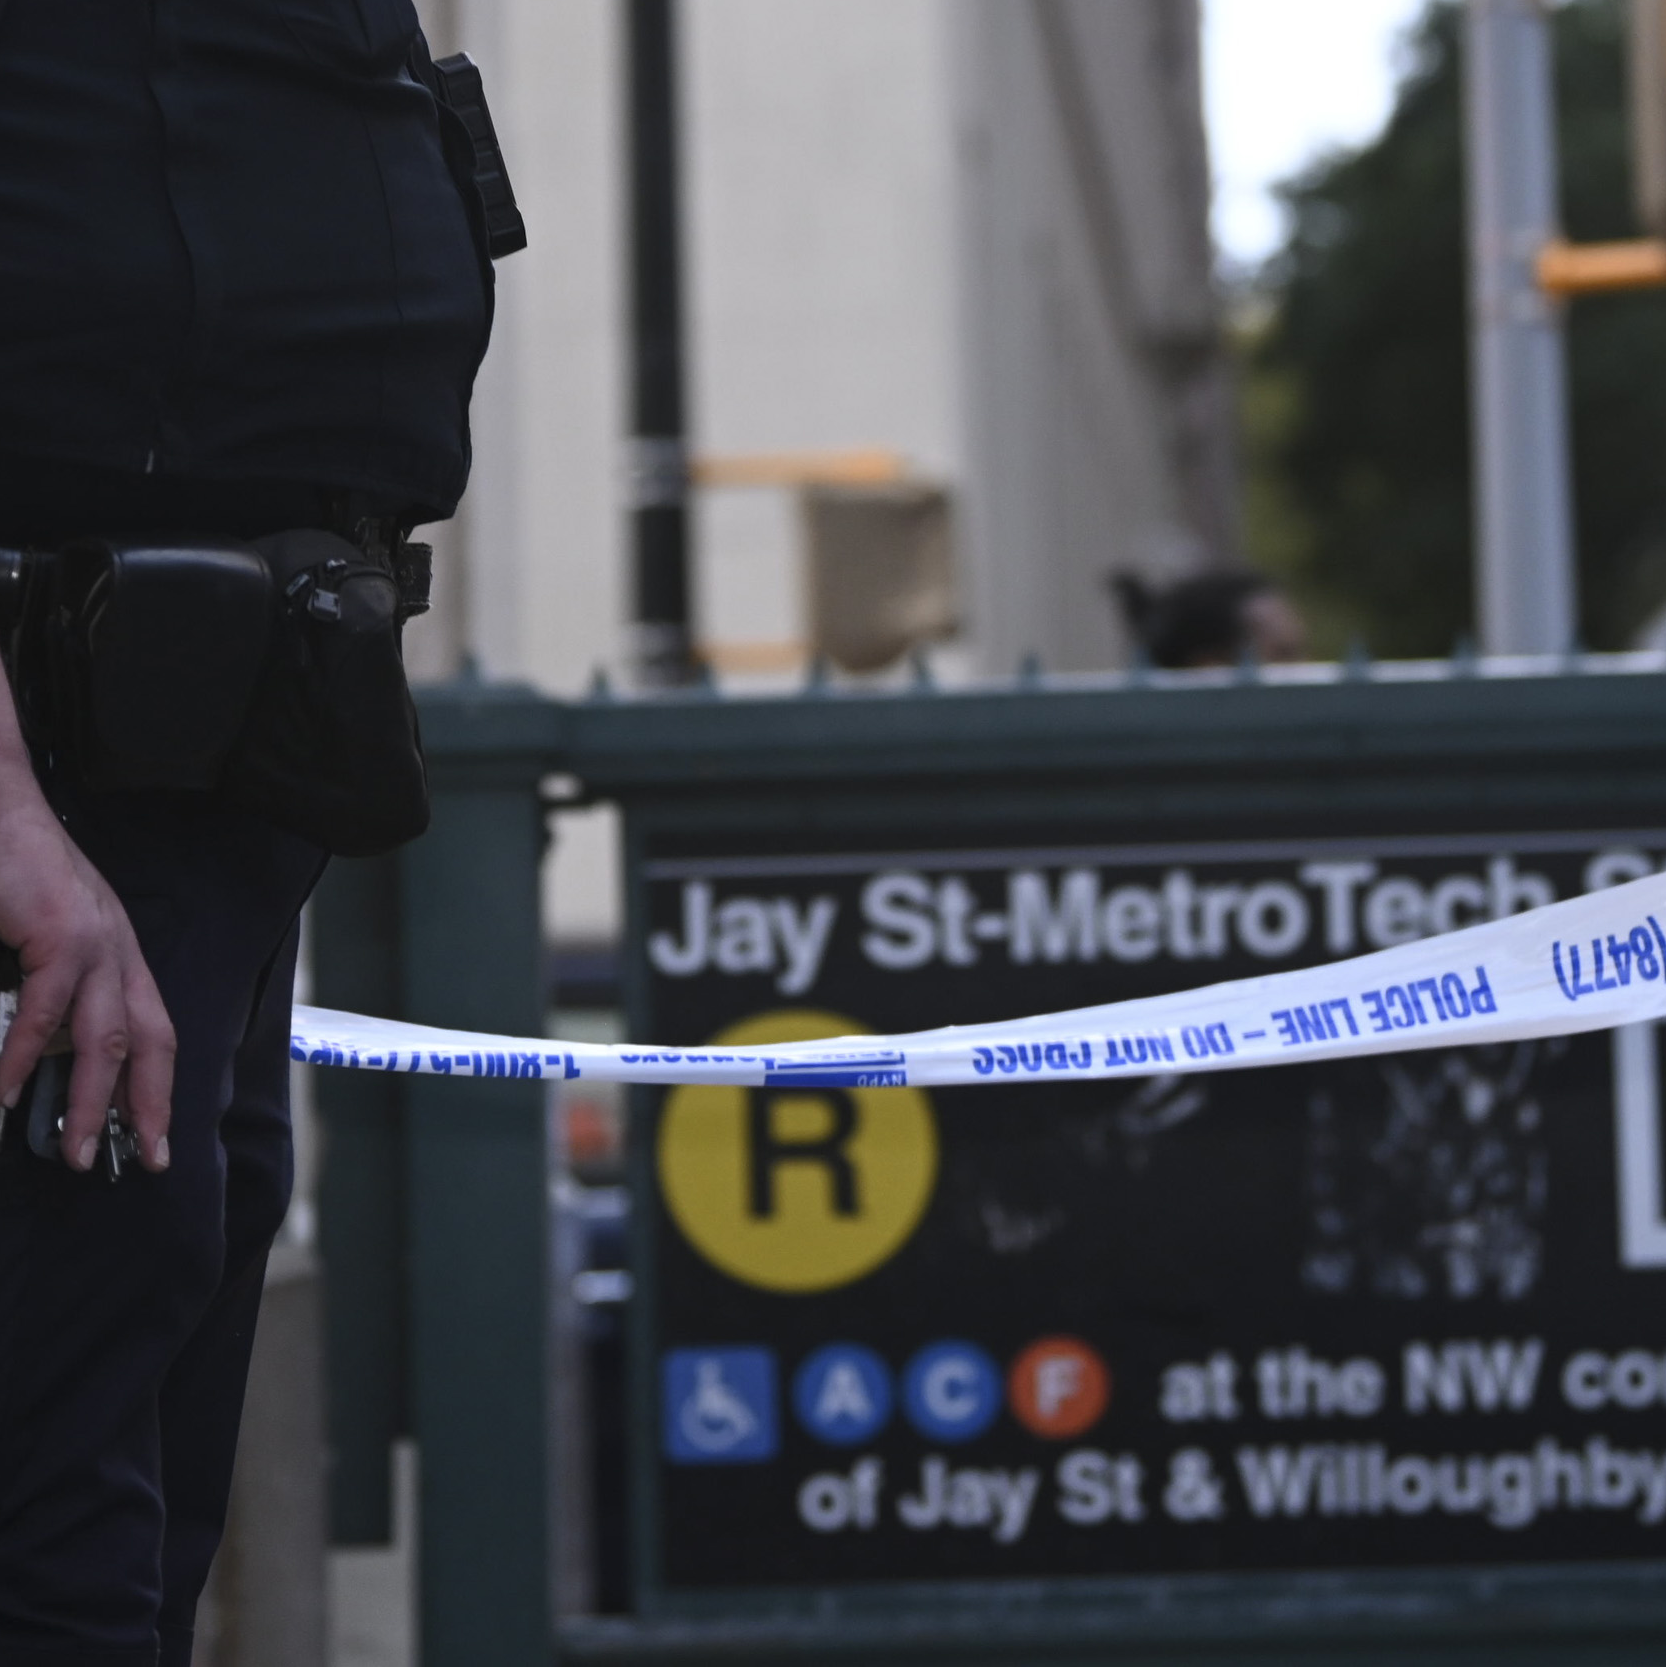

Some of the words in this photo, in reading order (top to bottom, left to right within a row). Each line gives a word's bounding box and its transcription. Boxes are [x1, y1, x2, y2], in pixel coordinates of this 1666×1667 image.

[647, 878, 836, 997] Jay
[860, 857, 1554, 970] St-MetroTech
[1271, 996, 1360, 1046] LINE
[1362, 965, 1497, 1033] POLICE
[1104, 1038, 1174, 1067] NOT
[1181, 1022, 1234, 1061] DO
[857, 1074, 903, 1086] NYPD
[748, 1087, 867, 1222] R
[815, 1364, 871, 1422] A
[923, 1360, 979, 1422] C
[1037, 1356, 1083, 1419] F
[1159, 1351, 1239, 1423] at
[1255, 1346, 1386, 1419] the
[1402, 1340, 1543, 1414] NW
[798, 1456, 883, 1532] of
[895, 1456, 1038, 1544] Jay
[1055, 1446, 1146, 1525] St
[1162, 1446, 1226, 1522] &
